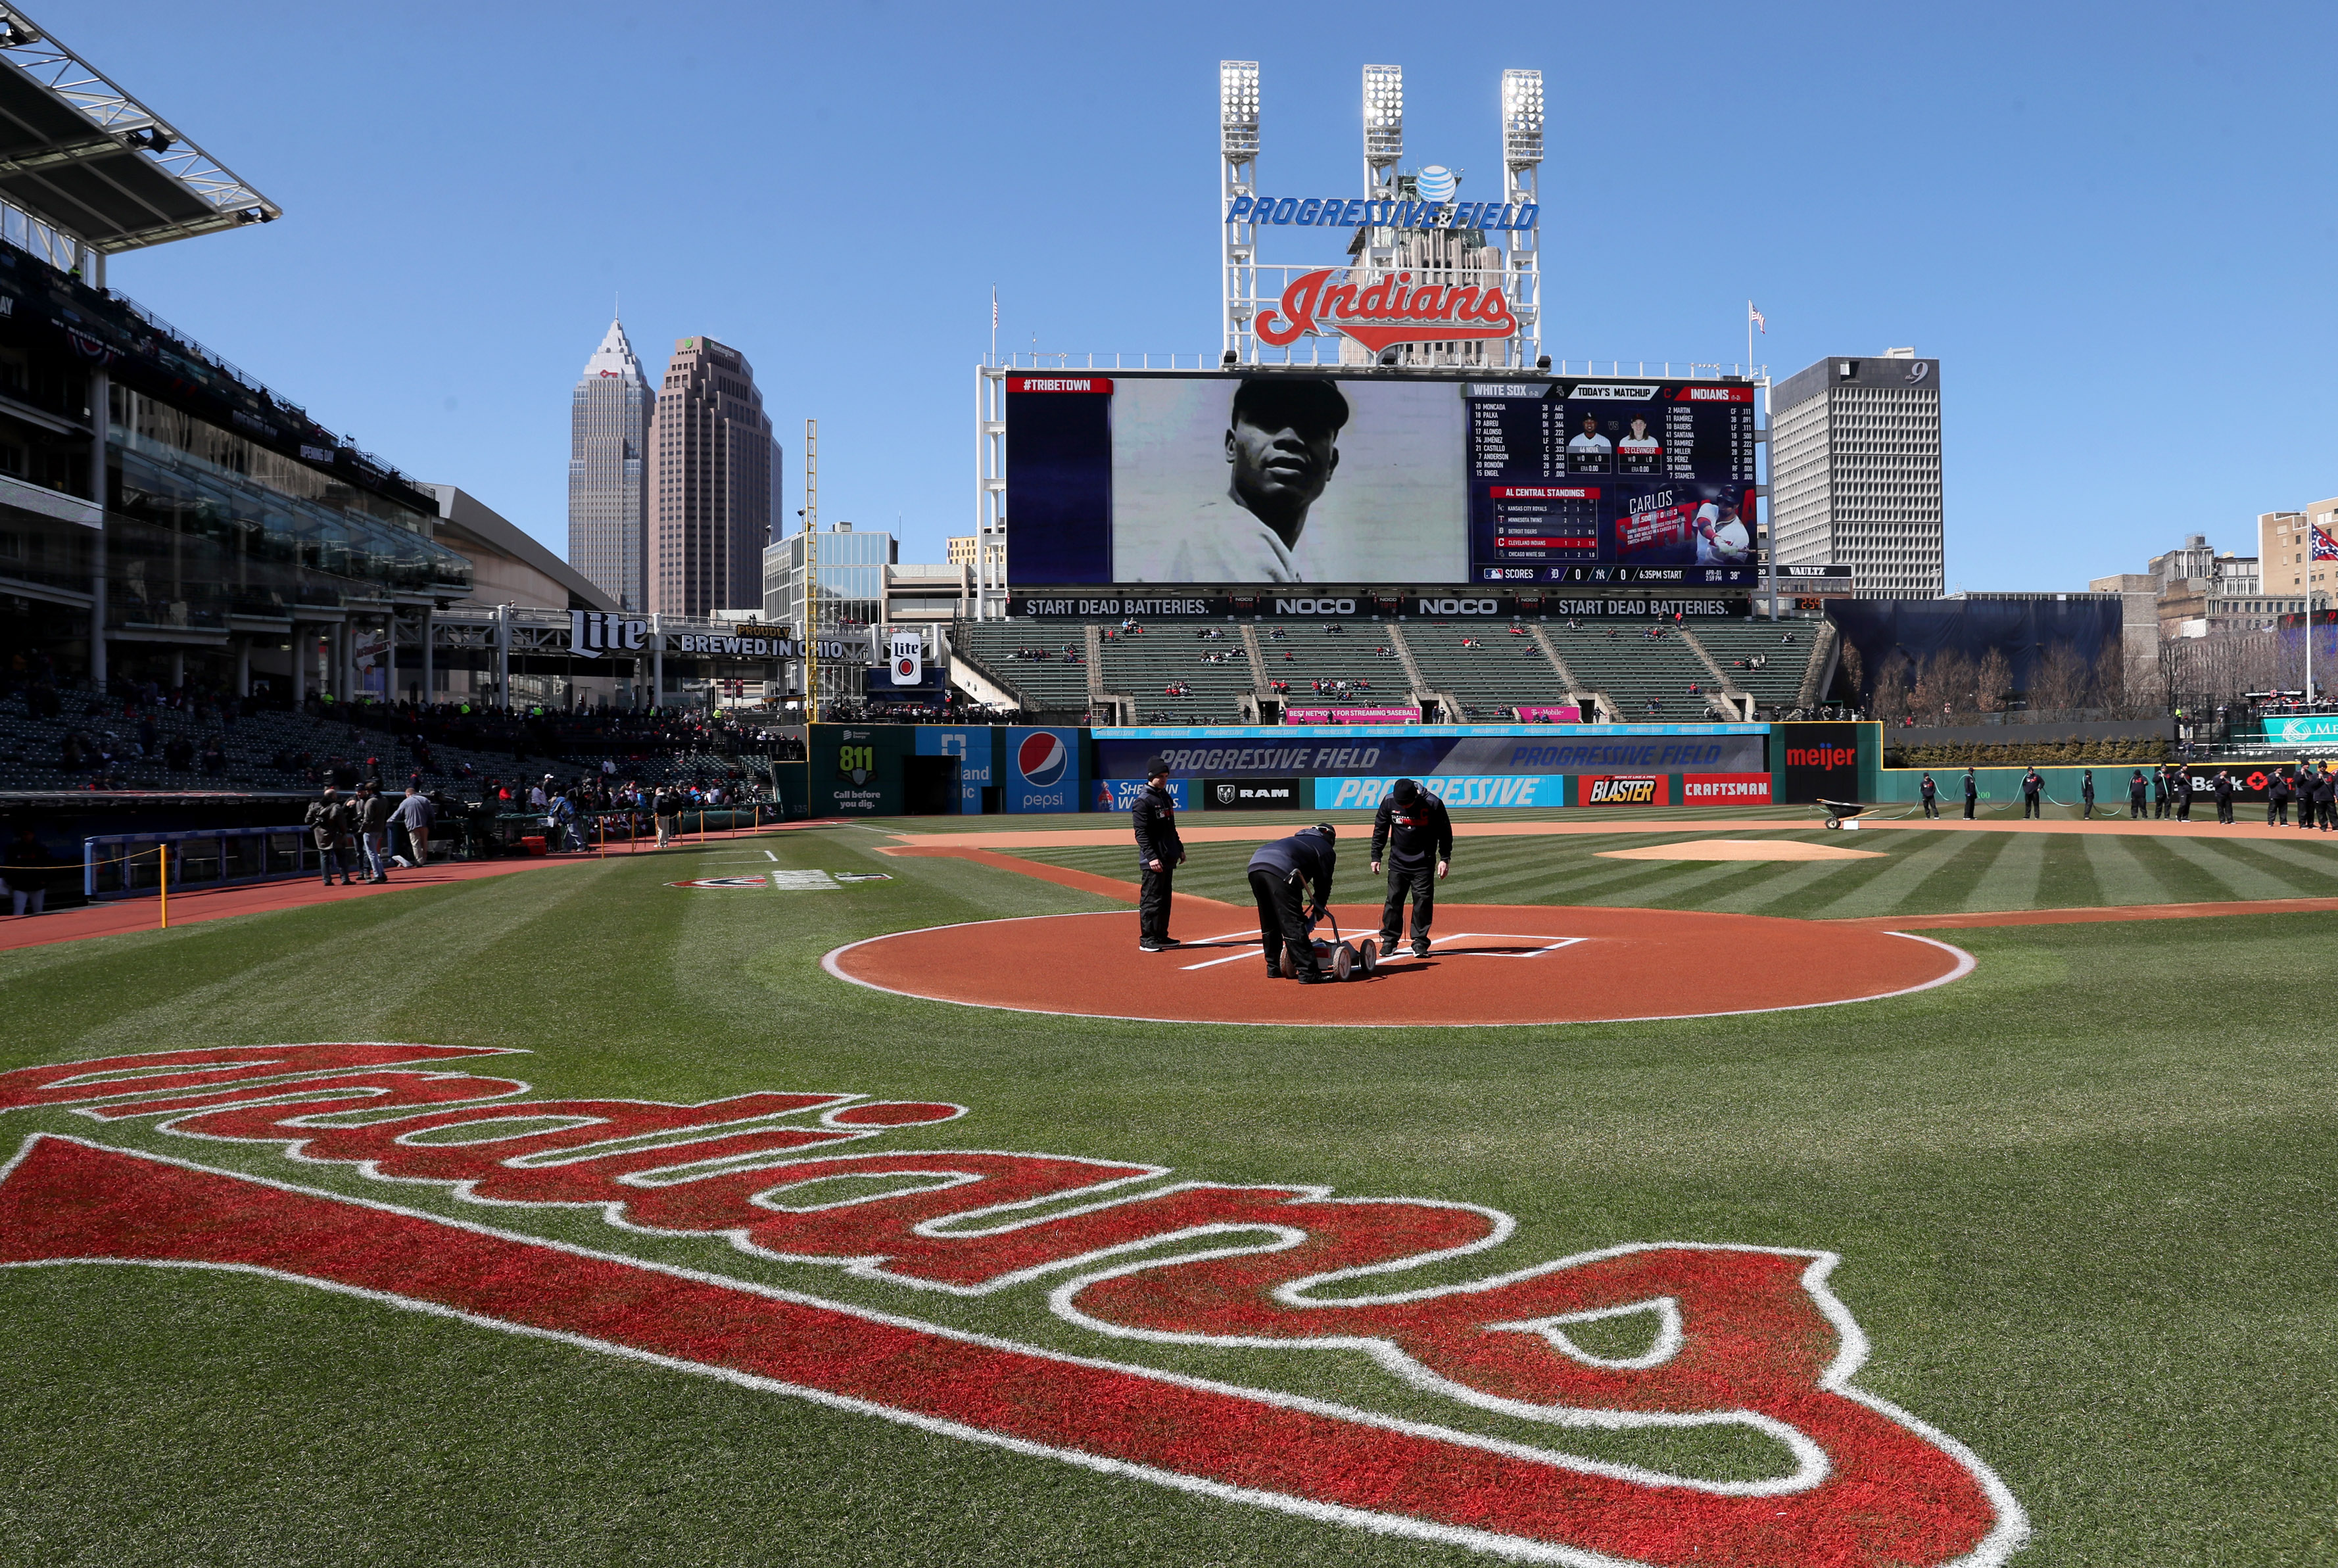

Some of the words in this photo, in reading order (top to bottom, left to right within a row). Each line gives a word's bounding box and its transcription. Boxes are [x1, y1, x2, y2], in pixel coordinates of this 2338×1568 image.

[1226, 196, 1447, 228] PROGRESSIVE
[1450, 202, 1540, 230] FIELD
[1254, 268, 1517, 355] Indians
[711, 341, 735, 358] Huntington
[1911, 362, 1929, 384] 9
[1024, 379, 1091, 391] #TRIBETOWN
[1473, 385, 1504, 395] WHITE
[1507, 385, 1526, 396] SOX
[1578, 388, 1610, 396] TODAY'S
[1614, 389, 1650, 397] MATCHUP
[1691, 389, 1729, 400] INDIANS
[1608, 421, 1619, 430] VS
[1630, 490, 1672, 514] CARLOS
[1506, 569, 1533, 579] SCORES
[1575, 569, 1581, 580] 0
[1621, 569, 1626, 580] 0
[1639, 570, 1661, 580] 6:35PM
[1663, 571, 1682, 579] START
[1789, 567, 1825, 575] VAULTZ
[1026, 600, 1076, 615] START
[1079, 600, 1119, 614] DEAD
[1124, 600, 1210, 615] BATTERIES.
[1276, 599, 1355, 614] NOCO
[1420, 599, 1497, 614] NOCO
[1559, 600, 1605, 615] START
[1608, 600, 1645, 614] DEAD
[1650, 600, 1729, 614] BATTERIES.
[1801, 598, 1820, 609] 2:59
[567, 609, 647, 658] Lite
[737, 625, 790, 638] PROUDLY
[681, 635, 767, 655] BREWED
[772, 640, 792, 656] IN
[798, 640, 843, 657] OHIO
[894, 642, 919, 657] Lite
[840, 746, 872, 771] 811
[1159, 749, 1310, 770] PROGRESSIVE
[1314, 748, 1380, 769] FIELD
[1510, 746, 1656, 767] PROGRESSIVE
[1659, 744, 1722, 765] FIELD
[1786, 742, 1855, 771] meijer
[1118, 782, 1179, 795] SHEIN
[1590, 780, 1655, 801] BLASTER
[1686, 782, 1767, 796] CRAFTSMAN
[2191, 776, 2243, 791] Bak
[1240, 789, 1289, 797] RAM
[1334, 778, 1540, 807] PRORESSIVE
[858, 799, 875, 809] dig.
[1024, 792, 1063, 809] pepsi
[792, 805, 807, 813] 325
